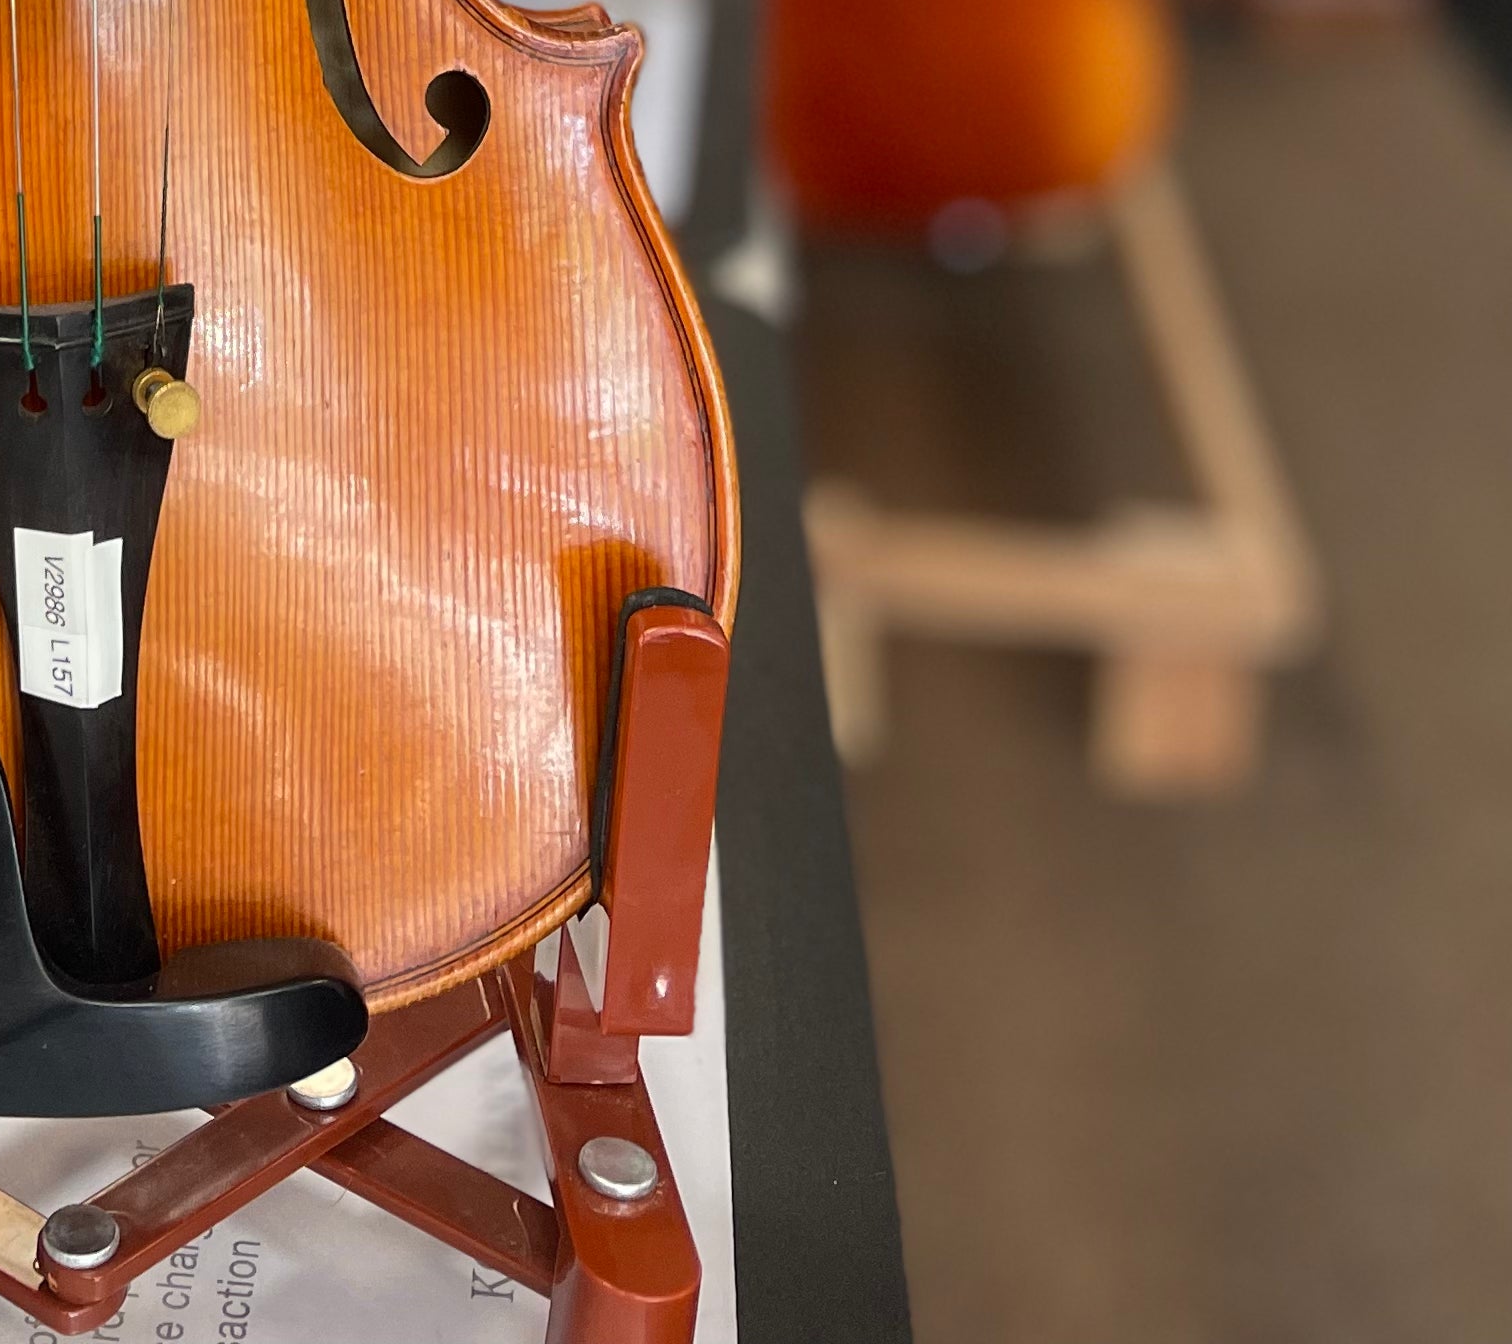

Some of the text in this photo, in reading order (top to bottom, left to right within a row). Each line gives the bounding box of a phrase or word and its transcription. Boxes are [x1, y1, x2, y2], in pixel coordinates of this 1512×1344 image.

[44, 556, 74, 697] V2986 L157
[216, 1240, 261, 1344] action
